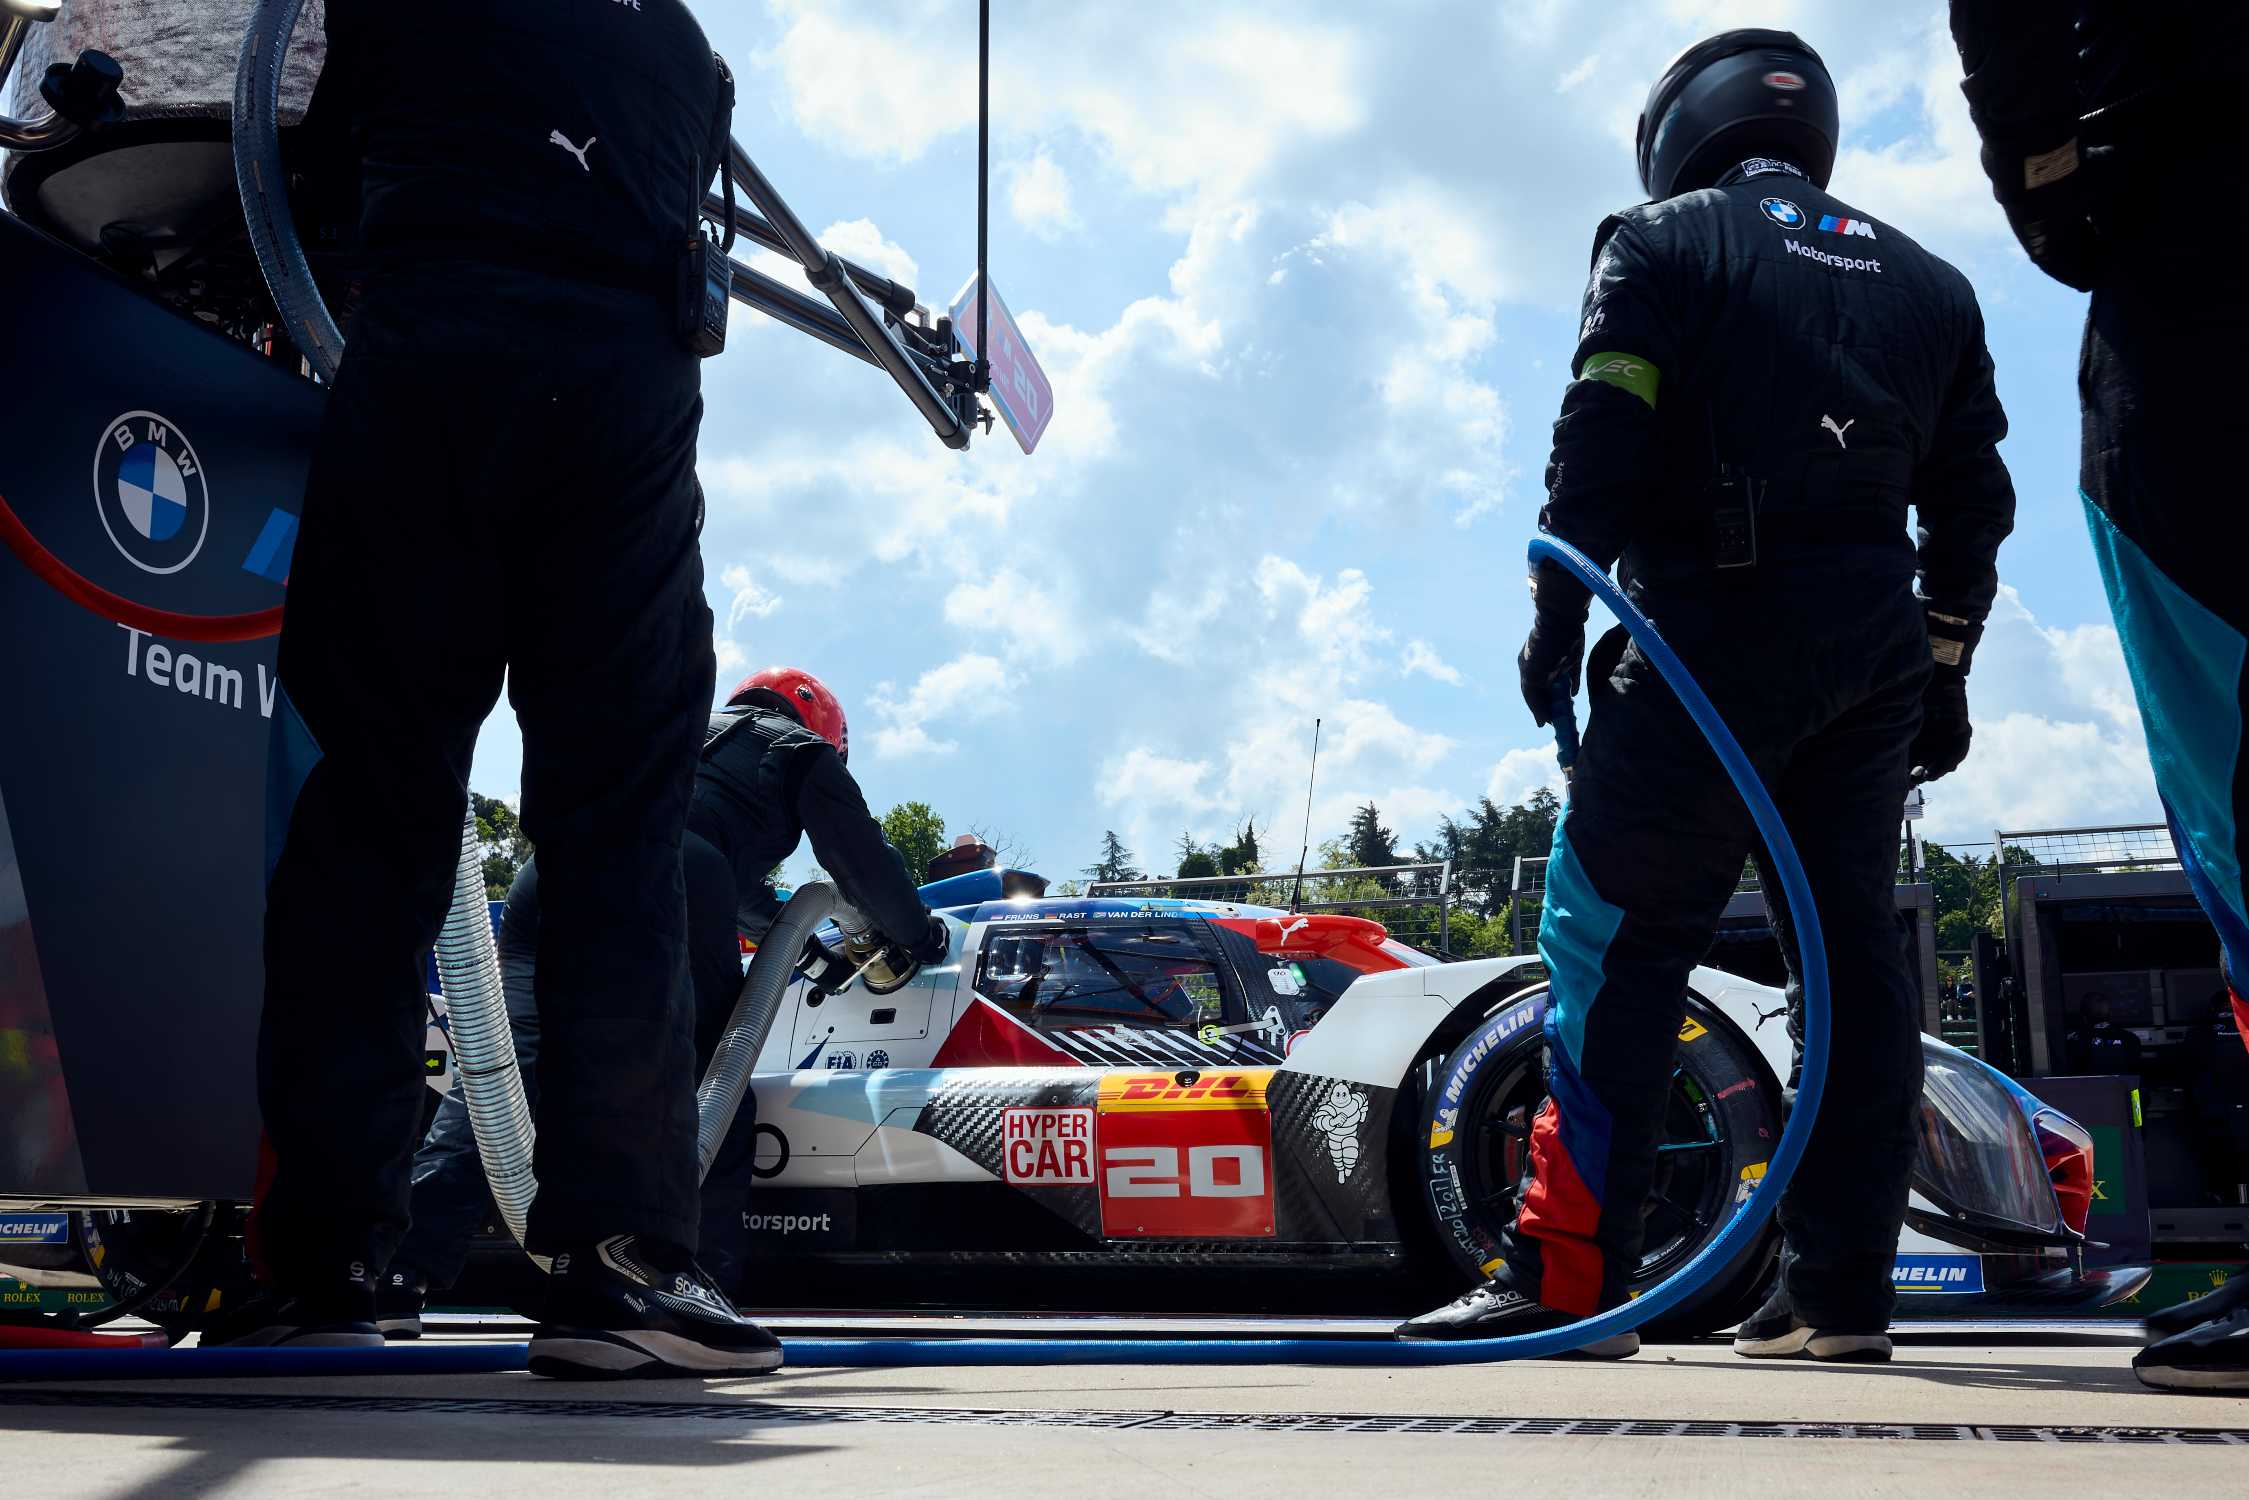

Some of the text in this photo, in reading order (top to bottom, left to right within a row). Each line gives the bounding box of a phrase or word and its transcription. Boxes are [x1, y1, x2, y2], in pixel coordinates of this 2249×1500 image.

[1764, 198, 1795, 210] BMW
[1784, 239, 1881, 274] Motorsport
[114, 420, 197, 478] BMW
[117, 622, 243, 710] Team
[1004, 913, 1040, 921] FRIJNS
[1058, 912, 1087, 920] RAST
[1108, 911, 1180, 919] VAN DER LIND
[827, 1056, 853, 1070] FIA
[1445, 1006, 1535, 1104] MICHELIN
[1120, 1076, 1249, 1101] DHL
[1008, 1113, 1088, 1139] HYPER
[1009, 1138, 1090, 1180] CAR
[1105, 1145, 1265, 1198] 20
[0, 1223, 59, 1235] ICHELIN
[742, 1211, 831, 1235] torsport
[1890, 1267, 1968, 1281] HELIN
[4, 1292, 41, 1303] ROLEX
[67, 1292, 105, 1303] ROLEX
[1487, 1290, 1524, 1309] spar
